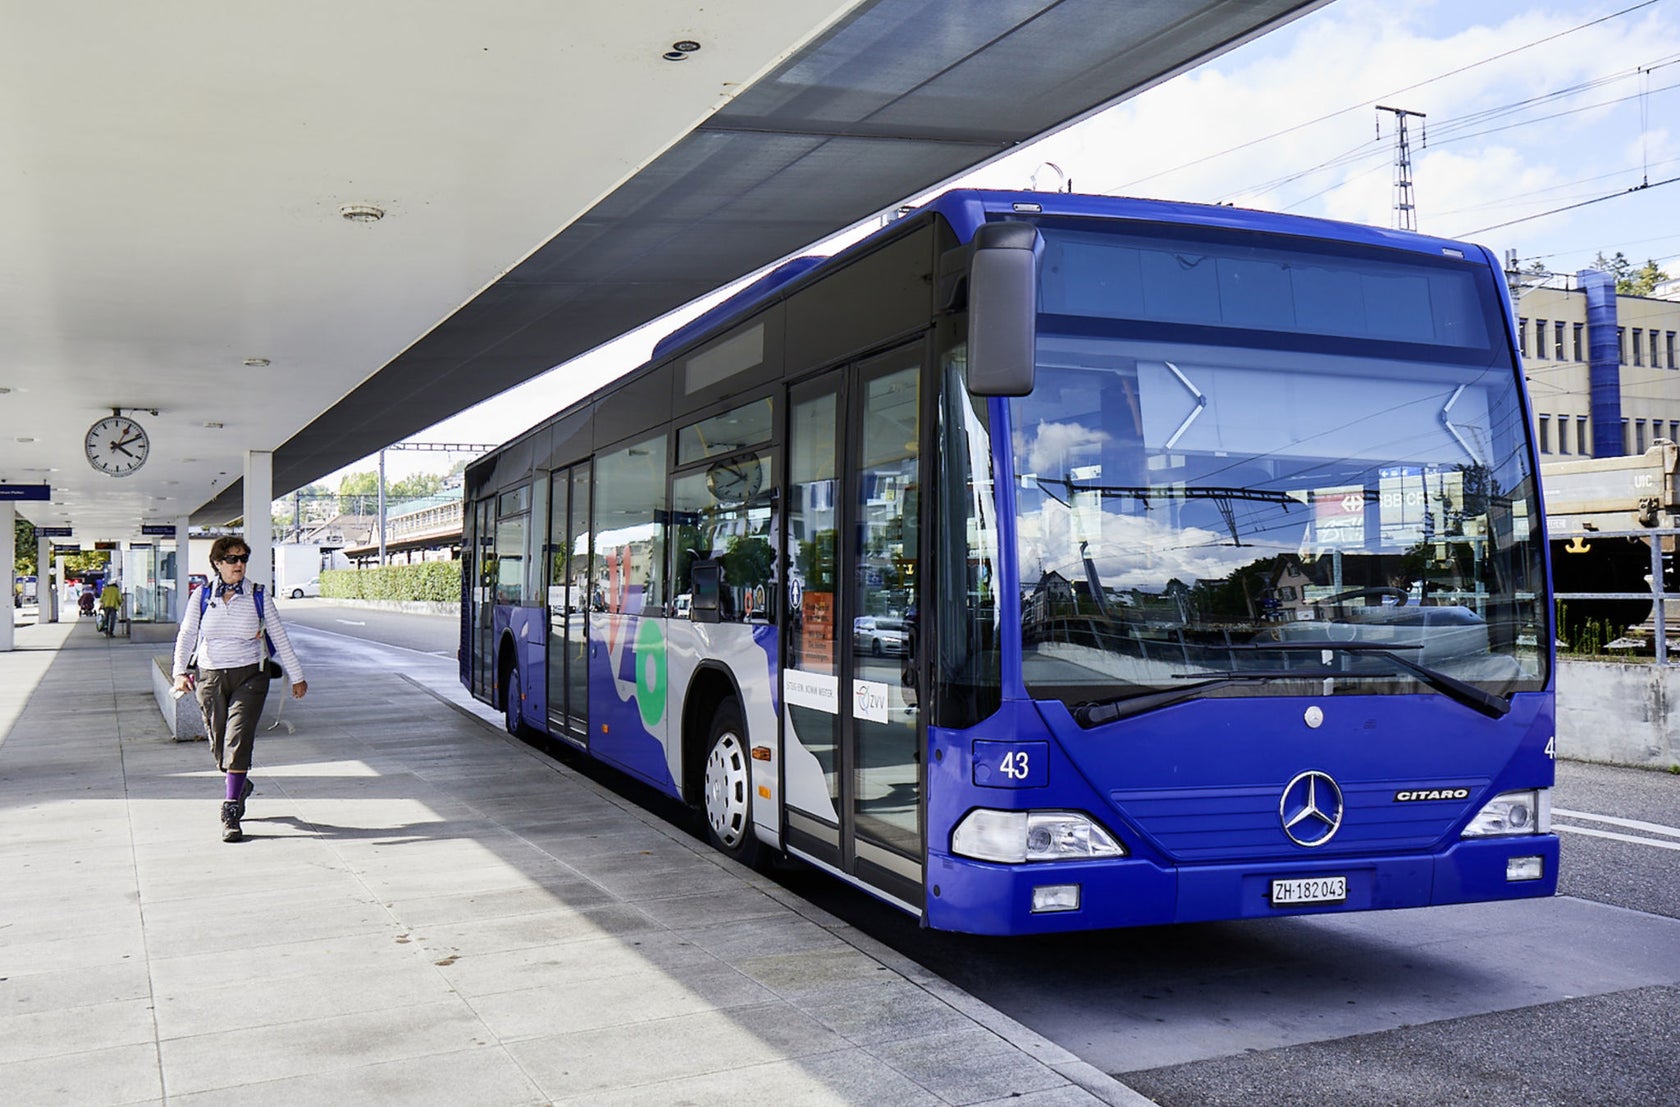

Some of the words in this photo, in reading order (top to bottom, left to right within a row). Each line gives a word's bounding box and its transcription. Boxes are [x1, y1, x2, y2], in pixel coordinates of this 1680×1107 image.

[1634, 474, 1653, 489] UIC
[870, 694, 885, 709] ZVV
[1544, 736, 1557, 759] 4
[1000, 751, 1029, 779] 43
[1397, 789, 1469, 802] CITARO
